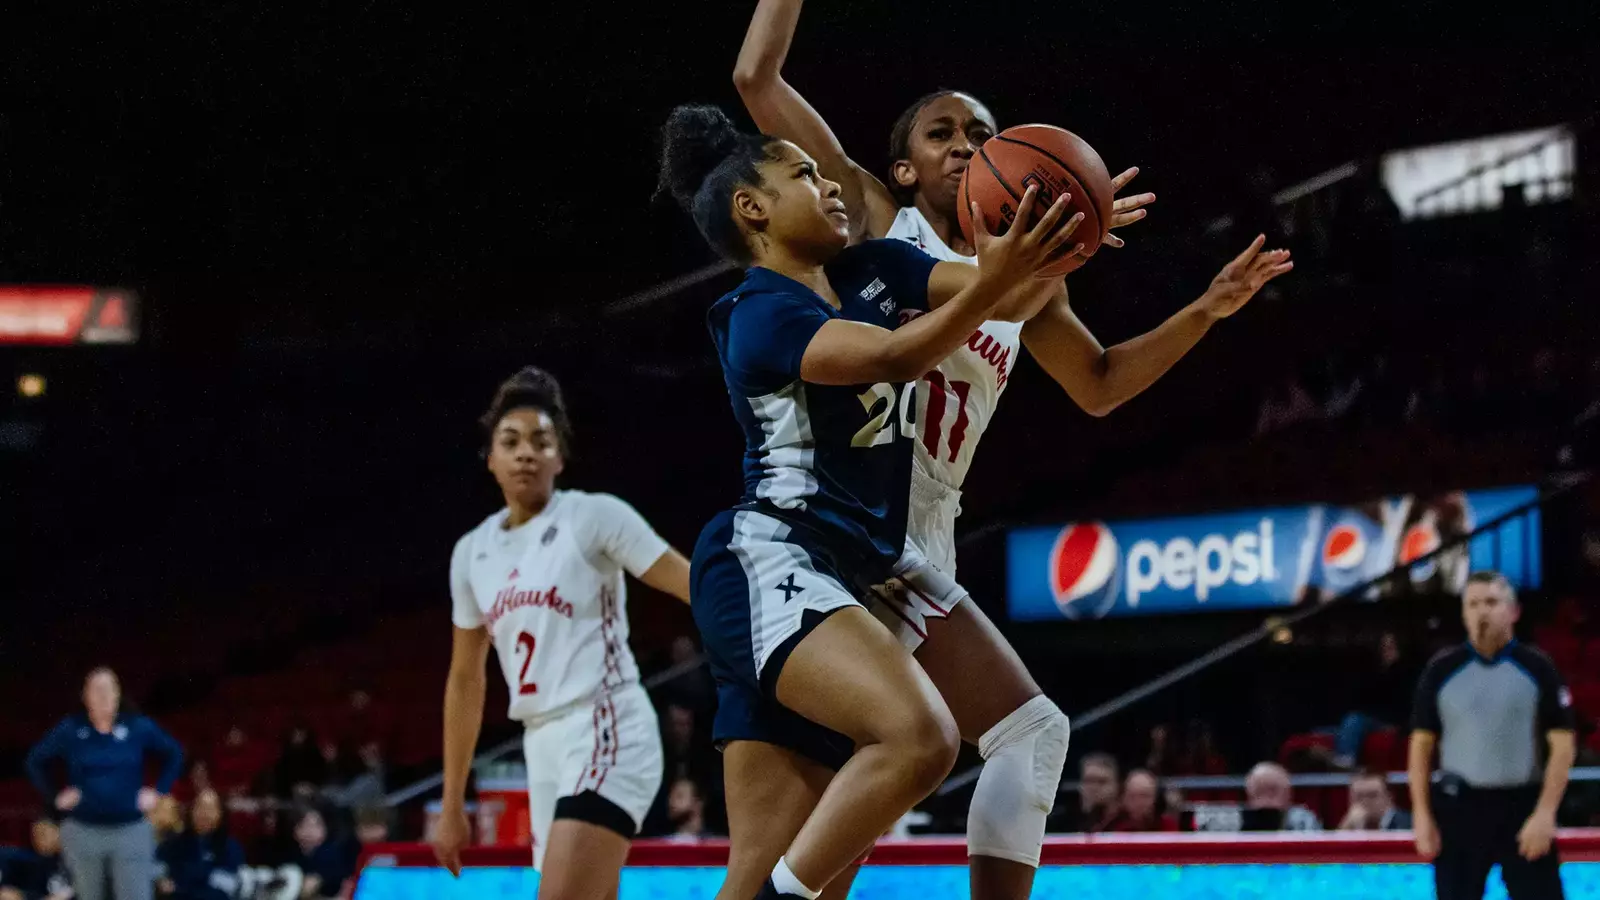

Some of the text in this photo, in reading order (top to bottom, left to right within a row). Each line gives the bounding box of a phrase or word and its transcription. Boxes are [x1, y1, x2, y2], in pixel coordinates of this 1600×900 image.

[923, 370, 971, 463] 11
[773, 572, 806, 604] X
[1125, 516, 1275, 609] pepsi
[515, 631, 537, 695] 2
